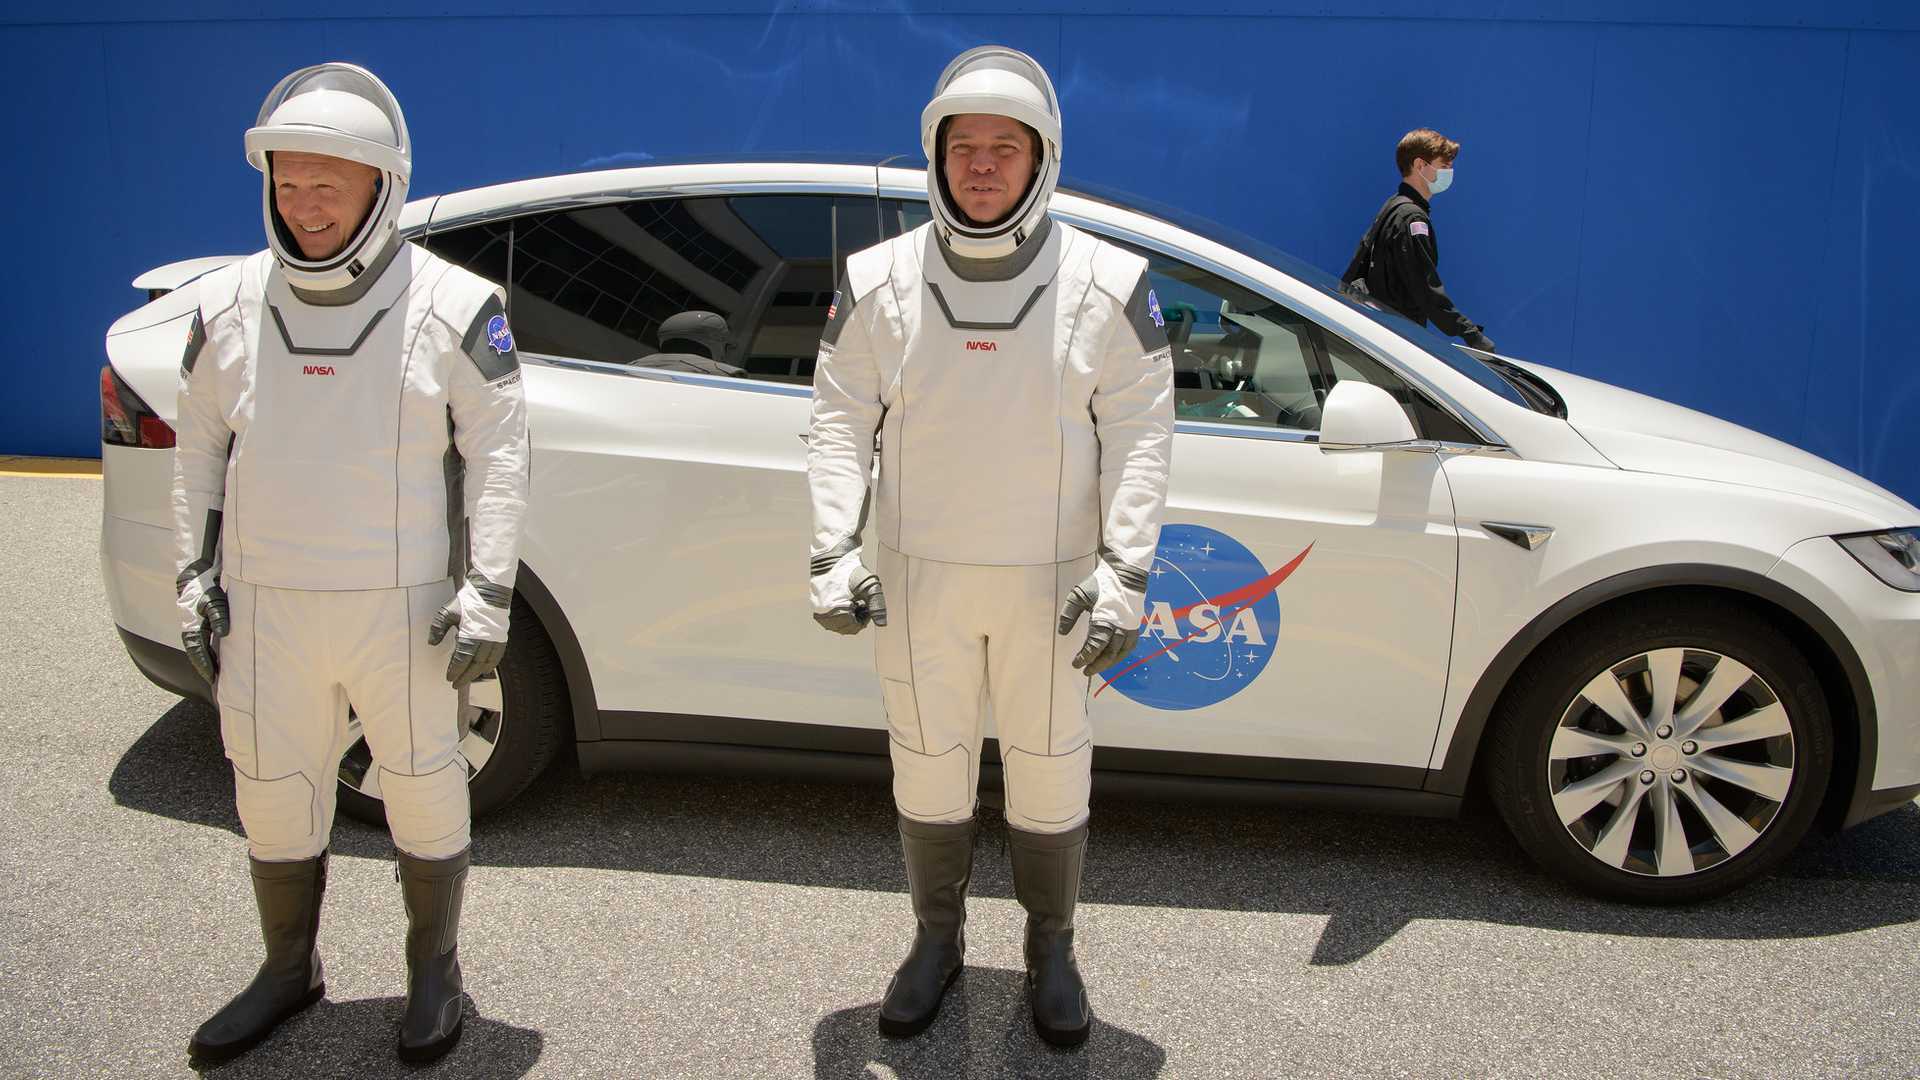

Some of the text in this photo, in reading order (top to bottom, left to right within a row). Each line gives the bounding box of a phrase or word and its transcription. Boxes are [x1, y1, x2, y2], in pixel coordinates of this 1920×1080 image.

[966, 341, 997, 351] NASA
[303, 365, 335, 376] NASA
[1140, 601, 1267, 646] ASA
